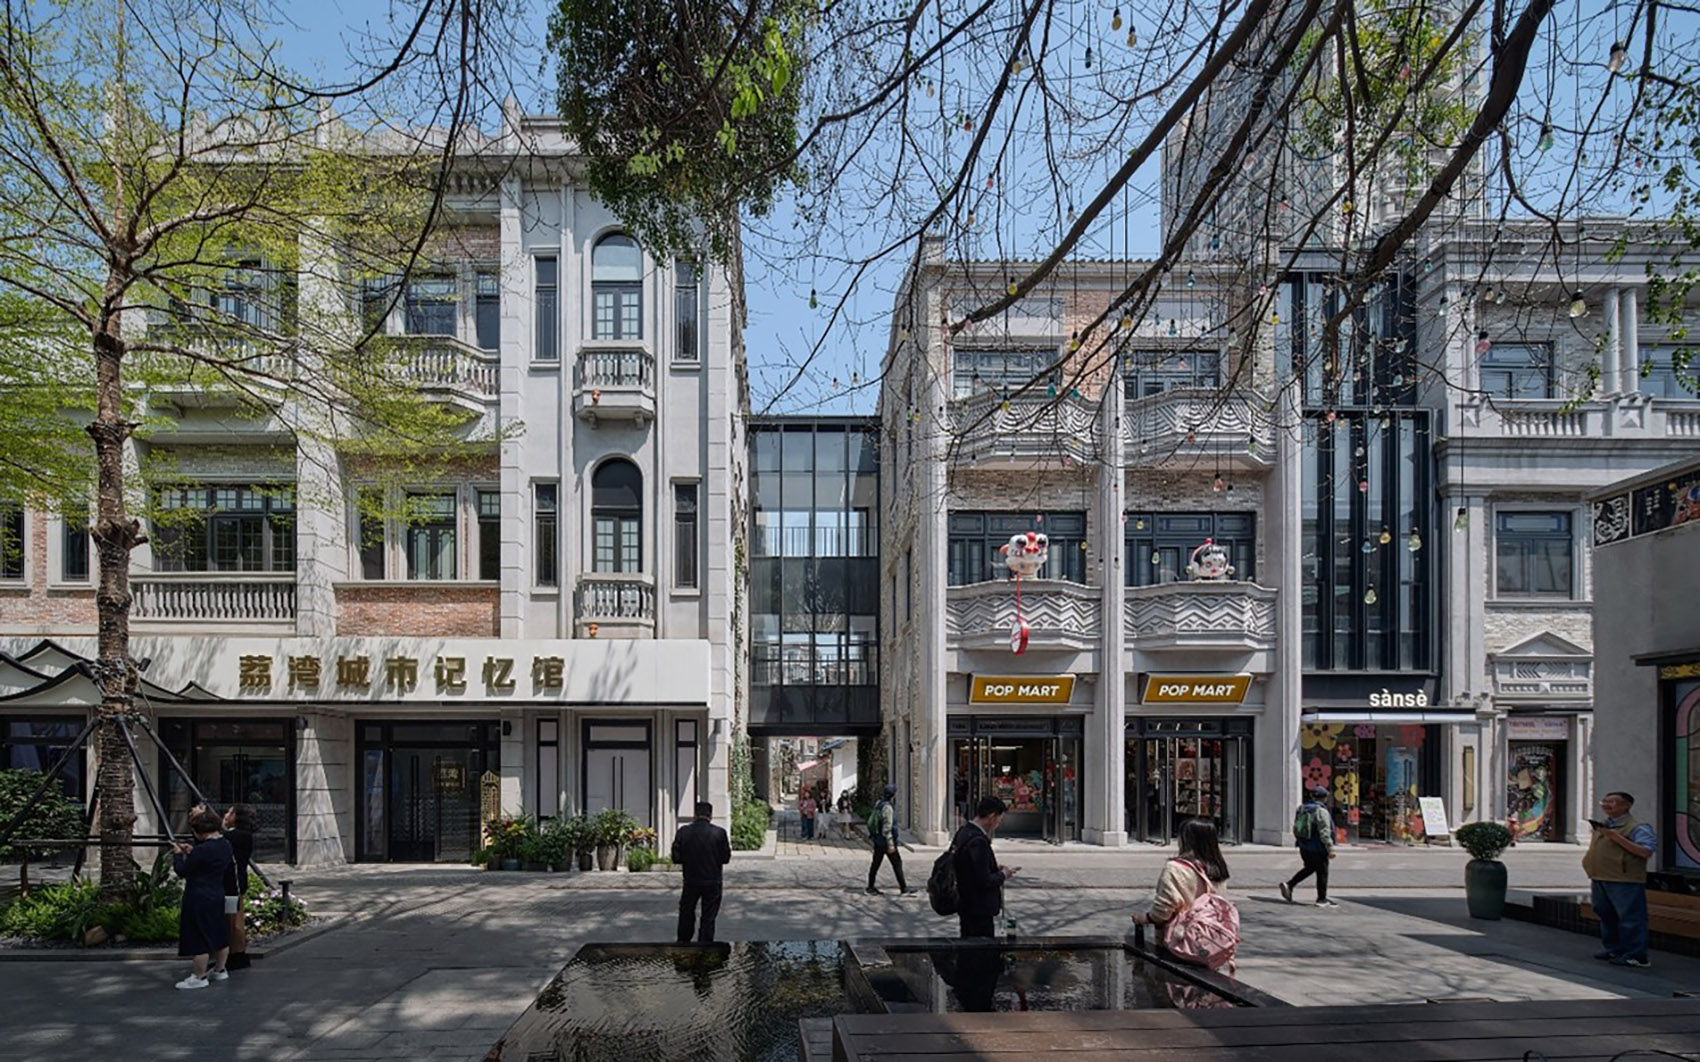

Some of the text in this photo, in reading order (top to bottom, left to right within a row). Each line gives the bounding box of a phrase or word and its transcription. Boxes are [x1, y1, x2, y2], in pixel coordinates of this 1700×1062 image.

[239, 655, 565, 691] 荔湾城市记忆馆
[984, 684, 1060, 697] POP MART
[1158, 684, 1235, 697] POP MART
[1369, 687, 1428, 707] sànsè
